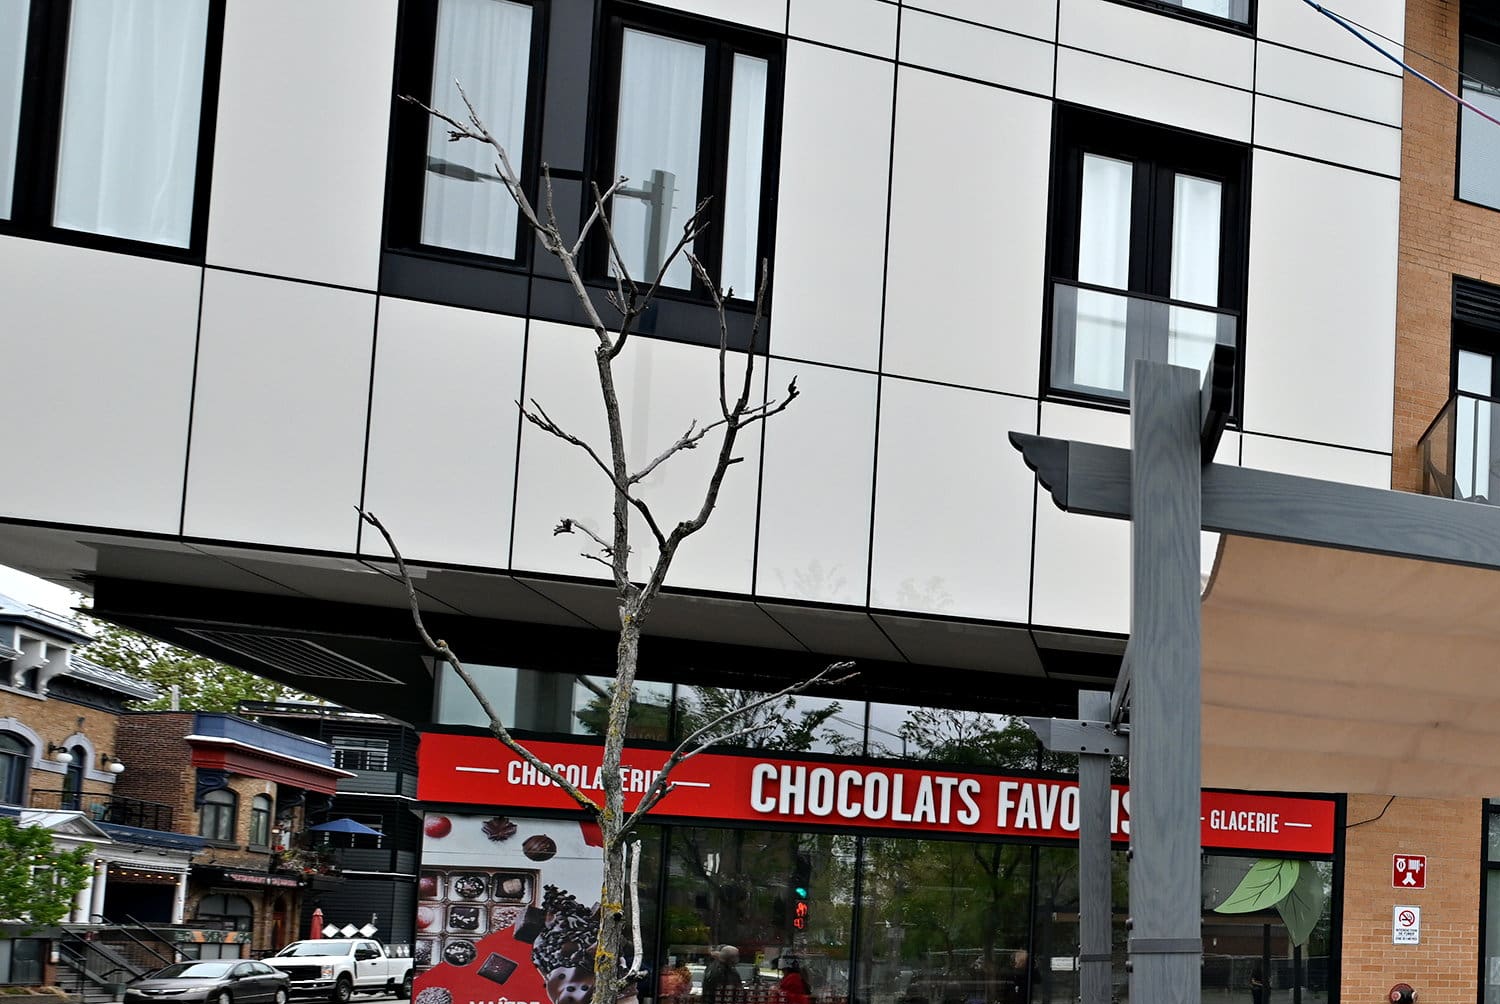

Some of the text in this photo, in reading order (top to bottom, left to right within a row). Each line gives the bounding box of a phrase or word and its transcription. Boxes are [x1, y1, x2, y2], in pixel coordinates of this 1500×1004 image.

[751, 763, 1130, 835] CHOCOLATS FAVOI
[1210, 809, 1280, 833] GLACERIE
